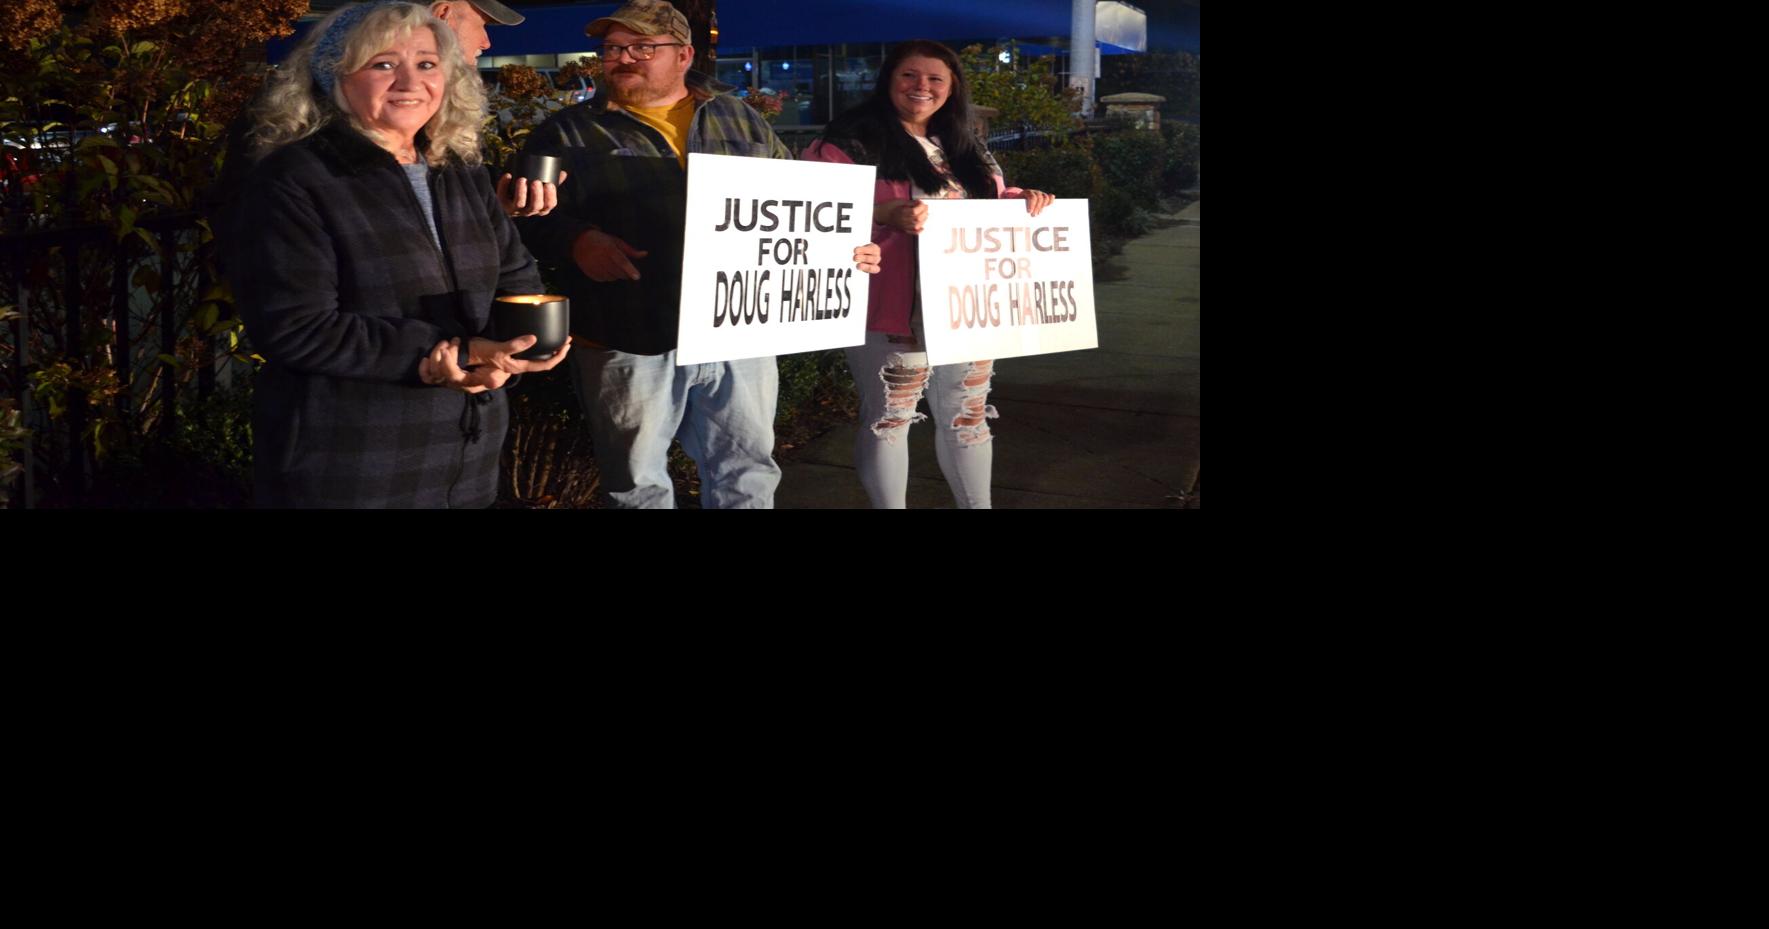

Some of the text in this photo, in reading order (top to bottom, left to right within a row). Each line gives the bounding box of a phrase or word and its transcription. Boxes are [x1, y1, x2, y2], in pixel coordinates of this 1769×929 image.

[715, 198, 853, 233] JUSTICE
[758, 238, 808, 266] FOR
[944, 226, 1070, 254] JUSTICE
[985, 258, 1032, 280] FOR
[713, 268, 852, 328] DOUG HARLESS
[948, 280, 1077, 330] DOUG HARLESS
